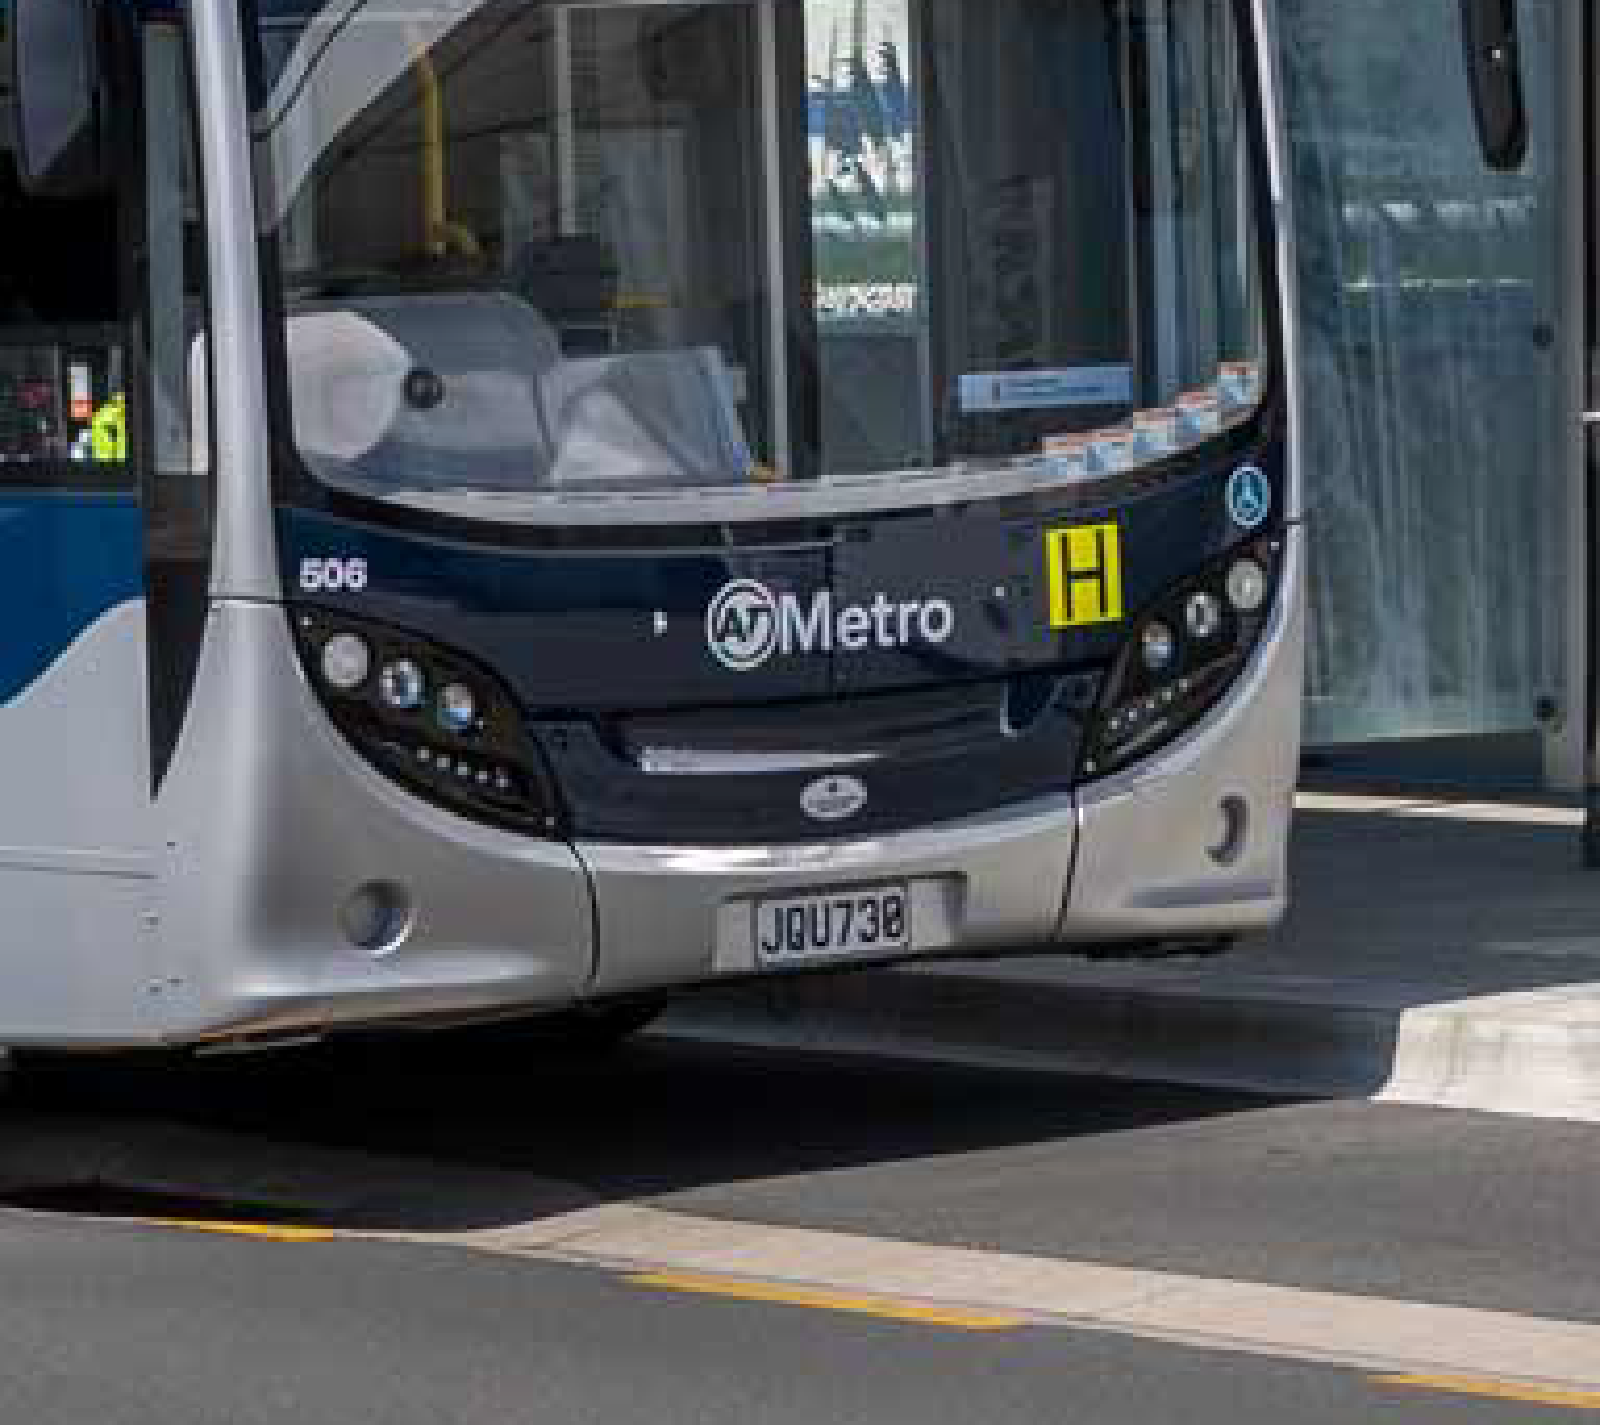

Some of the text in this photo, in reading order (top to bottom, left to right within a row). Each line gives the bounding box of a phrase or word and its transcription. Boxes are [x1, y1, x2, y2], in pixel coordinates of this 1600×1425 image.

[299, 557, 368, 592] 506
[778, 589, 955, 656] Metro
[760, 895, 905, 955] JQU730
